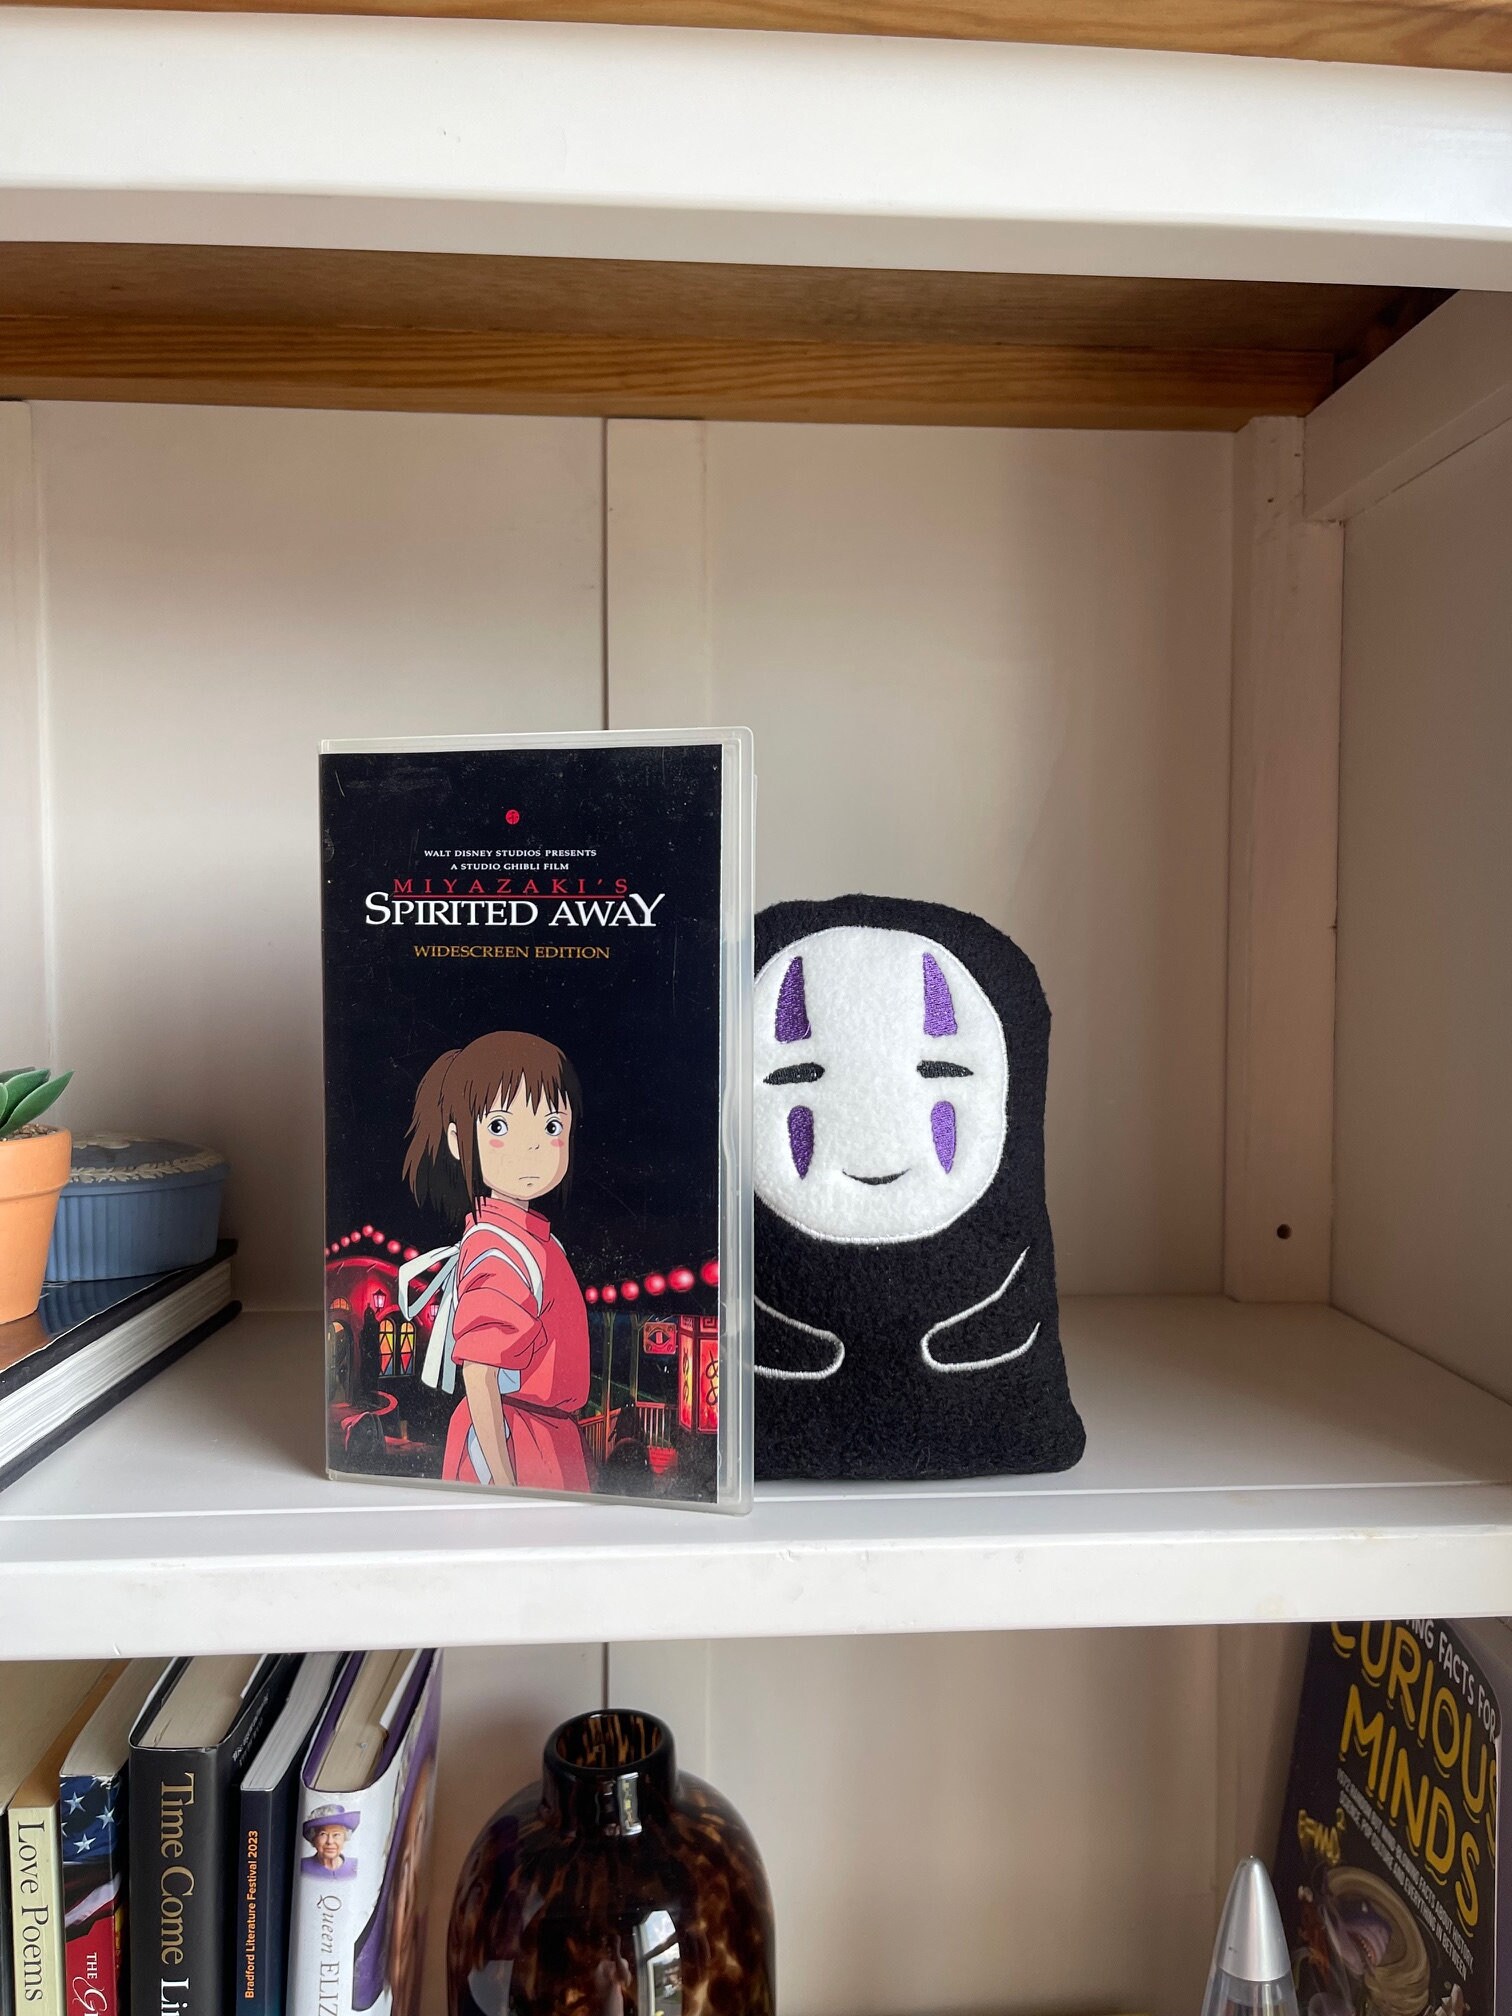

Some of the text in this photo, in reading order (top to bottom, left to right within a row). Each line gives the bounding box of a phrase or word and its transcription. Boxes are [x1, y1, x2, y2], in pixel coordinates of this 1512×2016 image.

[424, 849, 597, 857] WALT DISNEY STUDIOS PRESENTS
[450, 862, 569, 871] A STUDIO GHIBLI FILM
[365, 891, 666, 927] SPIRITED AWAY
[394, 878, 628, 894] MIYAZAKI'S
[413, 945, 610, 960] WIDESCREEN EDITION
[1438, 1631, 1475, 1705] FACTS
[1477, 1684, 1497, 1743] FOR
[1340, 1684, 1480, 1926] MINDS
[160, 1772, 195, 1965] Time Come
[17, 1821, 49, 2001] Love Poems
[244, 1830, 259, 1999] Bradford Literature Festival 2023
[316, 1895, 342, 1954] Queen
[72, 1952, 108, 2016] THE G
